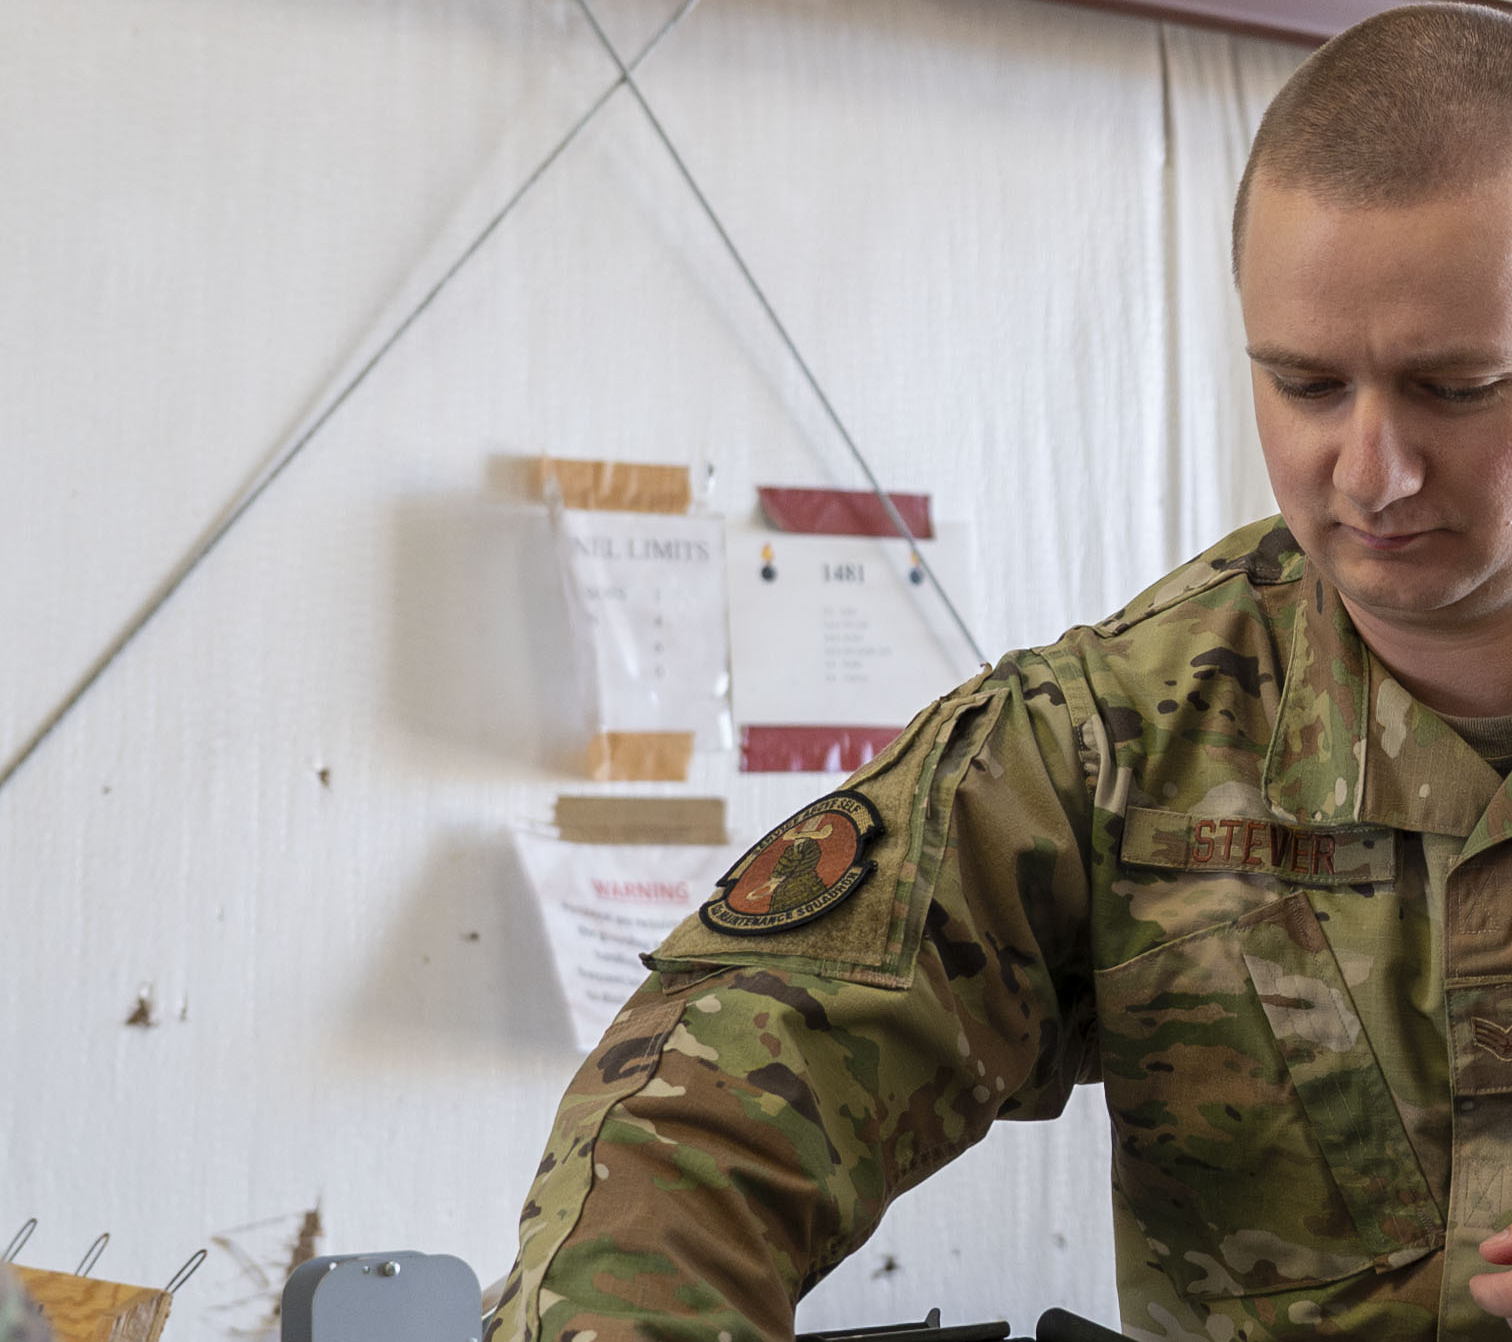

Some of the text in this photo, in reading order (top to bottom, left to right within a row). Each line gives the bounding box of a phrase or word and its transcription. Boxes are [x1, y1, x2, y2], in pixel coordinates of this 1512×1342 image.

[627, 538, 711, 562] LIMITS
[822, 562, 865, 583] 1481
[1192, 819, 1336, 875] STEVER
[591, 878, 689, 901] WARNING
[796, 871, 859, 917] SQUADRON
